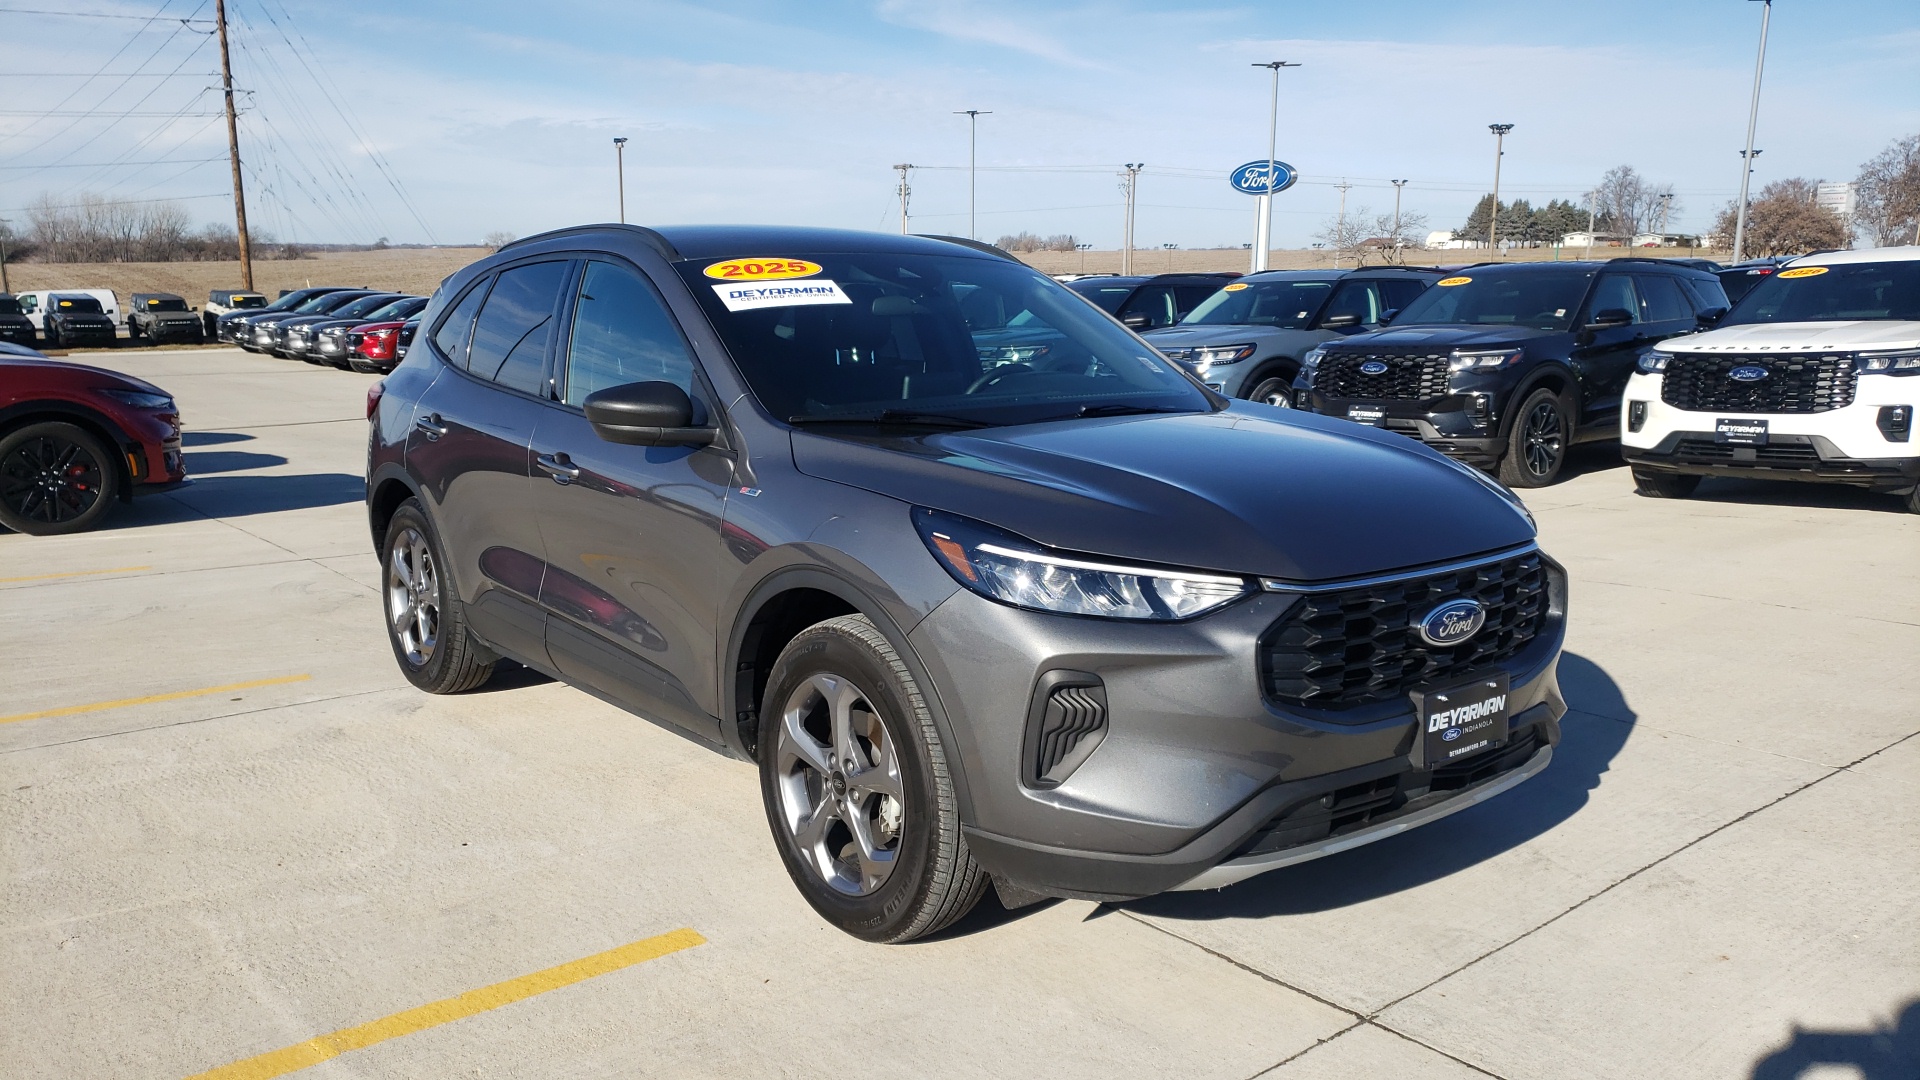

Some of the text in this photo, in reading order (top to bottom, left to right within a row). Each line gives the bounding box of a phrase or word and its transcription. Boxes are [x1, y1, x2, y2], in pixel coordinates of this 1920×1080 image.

[1241, 167, 1279, 188] Ford
[720, 261, 807, 277] 2025
[729, 286, 834, 299] DEYARMAN
[740, 294, 785, 302] CERTIFIED
[1717, 424, 1766, 434] DEYARMAN
[1439, 610, 1474, 638] Ford
[1428, 694, 1507, 733] DEYARMAN
[1462, 718, 1493, 735] INDIANOLA
